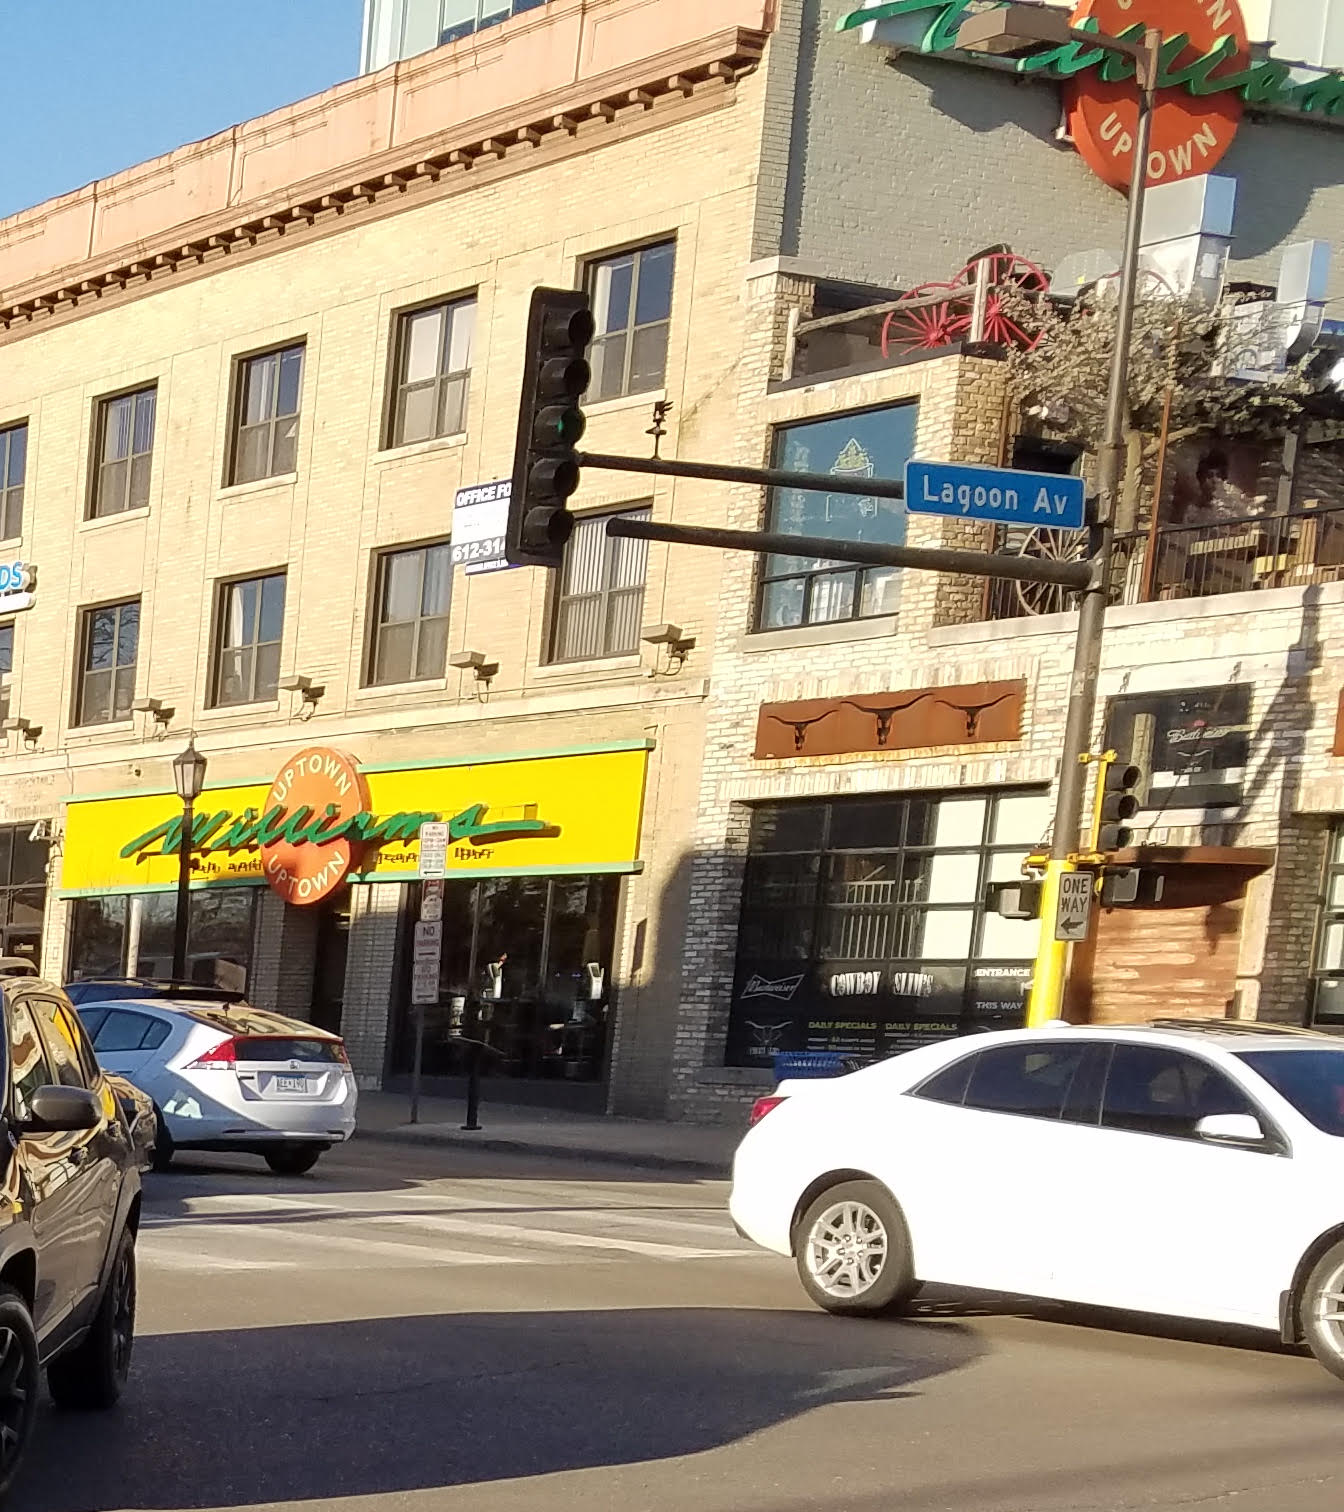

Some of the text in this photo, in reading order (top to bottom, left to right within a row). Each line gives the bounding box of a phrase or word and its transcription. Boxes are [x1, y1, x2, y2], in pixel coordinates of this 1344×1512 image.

[1100, 112, 1217, 178] UPOWN
[456, 485, 497, 507] OFFICE
[923, 474, 1068, 514] Lagoon Av
[273, 754, 352, 802] UPTOWN
[119, 804, 545, 858] Williams
[268, 851, 345, 898] UPTOWN
[1063, 877, 1089, 894] ONE
[1060, 896, 1088, 913] WAY
[423, 926, 435, 936] NO
[975, 968, 1031, 977] ENTRANCE
[831, 971, 881, 997] COWBOY
[976, 1001, 1024, 1010] THIS WAY
[808, 1021, 878, 1030] DAILY SPECIALS
